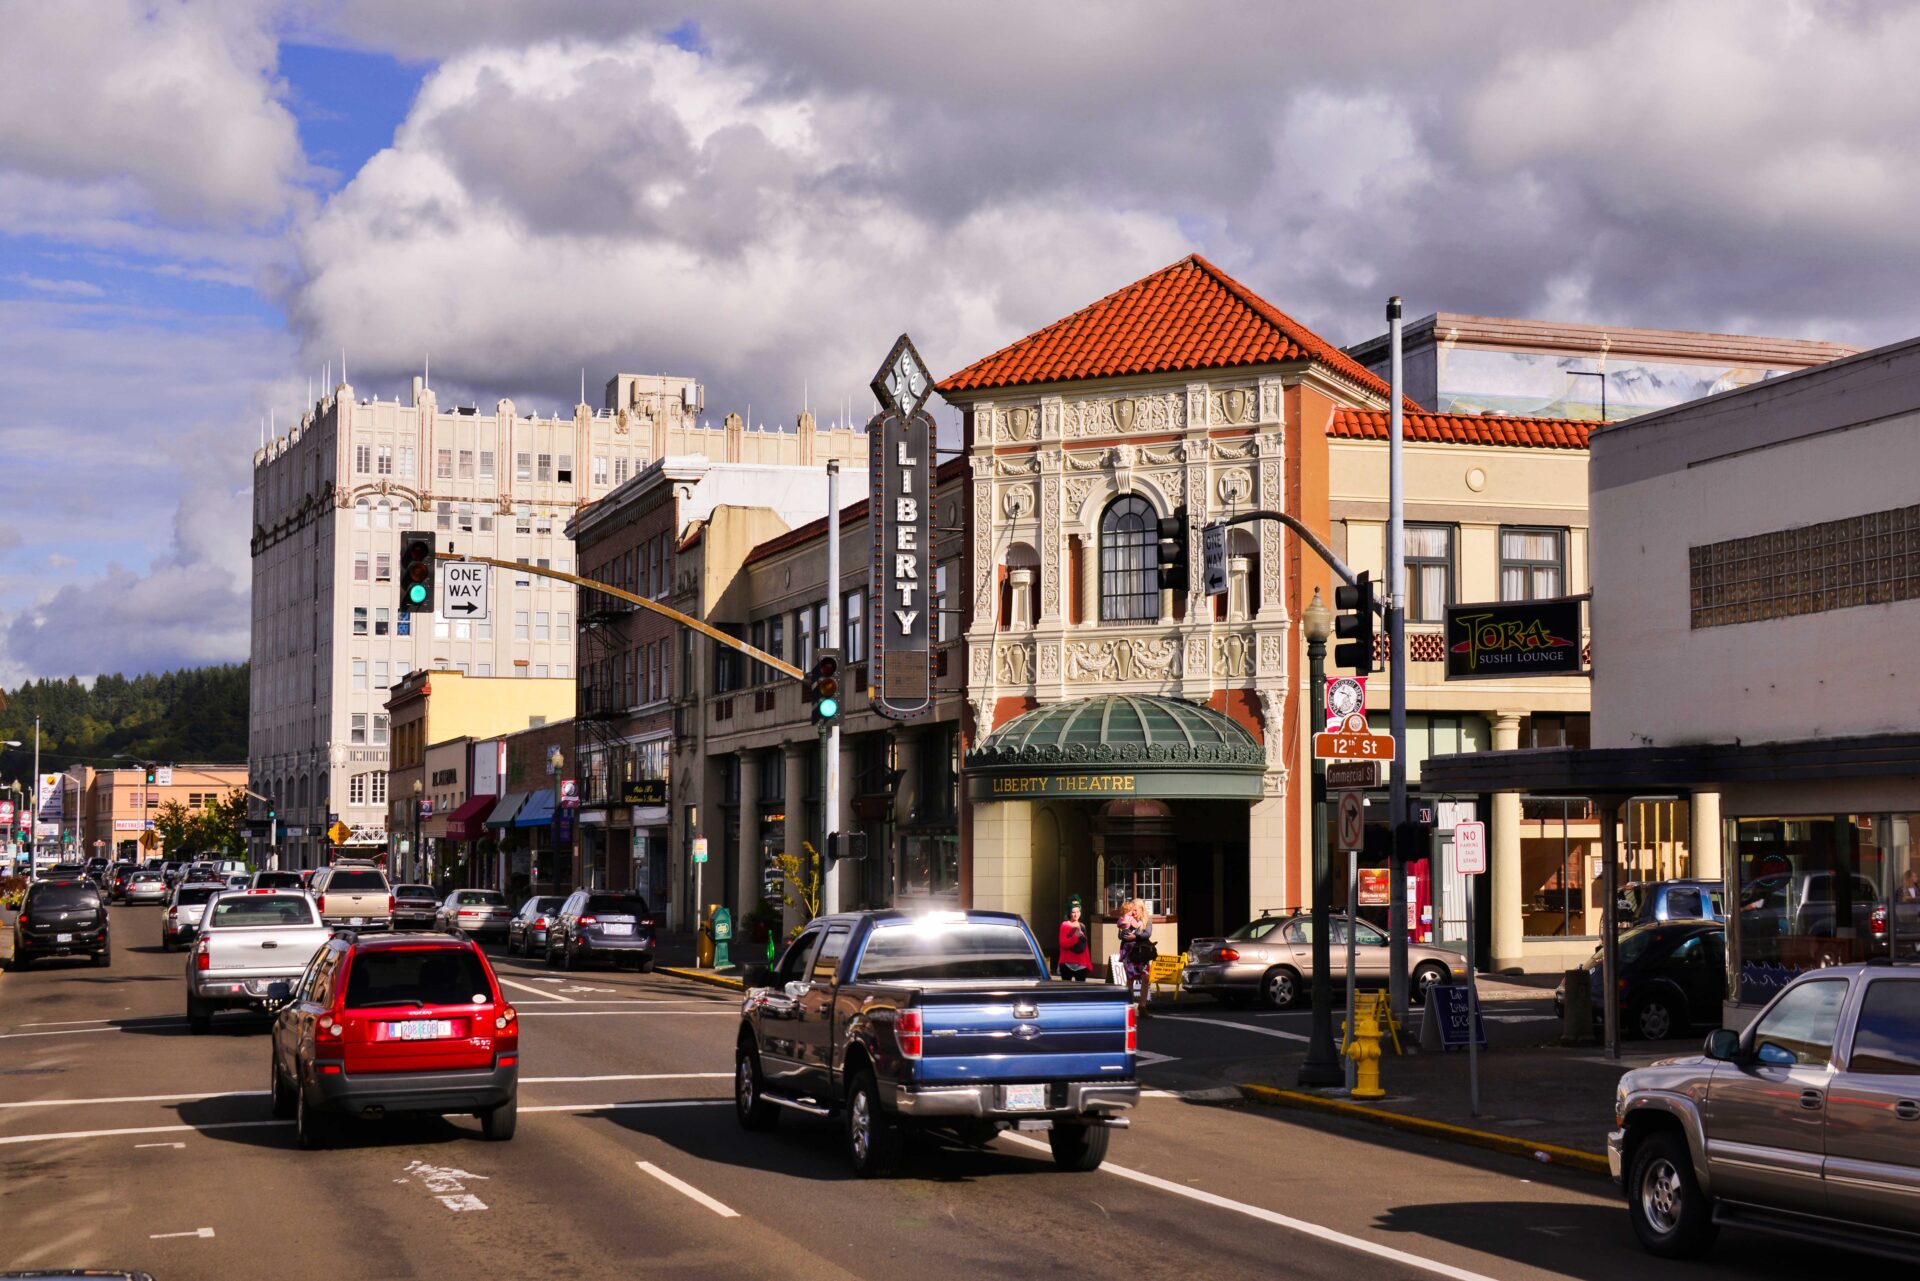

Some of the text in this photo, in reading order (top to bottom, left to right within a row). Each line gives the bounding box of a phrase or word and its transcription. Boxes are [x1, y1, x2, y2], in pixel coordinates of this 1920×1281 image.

[894, 441, 919, 635] LIBERTY
[1207, 534, 1222, 550] ONE
[1207, 551, 1223, 569] WAY
[450, 568, 482, 581] ONE
[449, 584, 482, 597] WAY
[1456, 613, 1554, 669] TORA
[1479, 651, 1564, 664] SUSHI LOUNGE
[1333, 738, 1377, 754] 12th St
[1328, 766, 1374, 784] Commercial St
[993, 775, 1135, 792] LIBERTY THEATRE
[1463, 831, 1476, 841] NO
